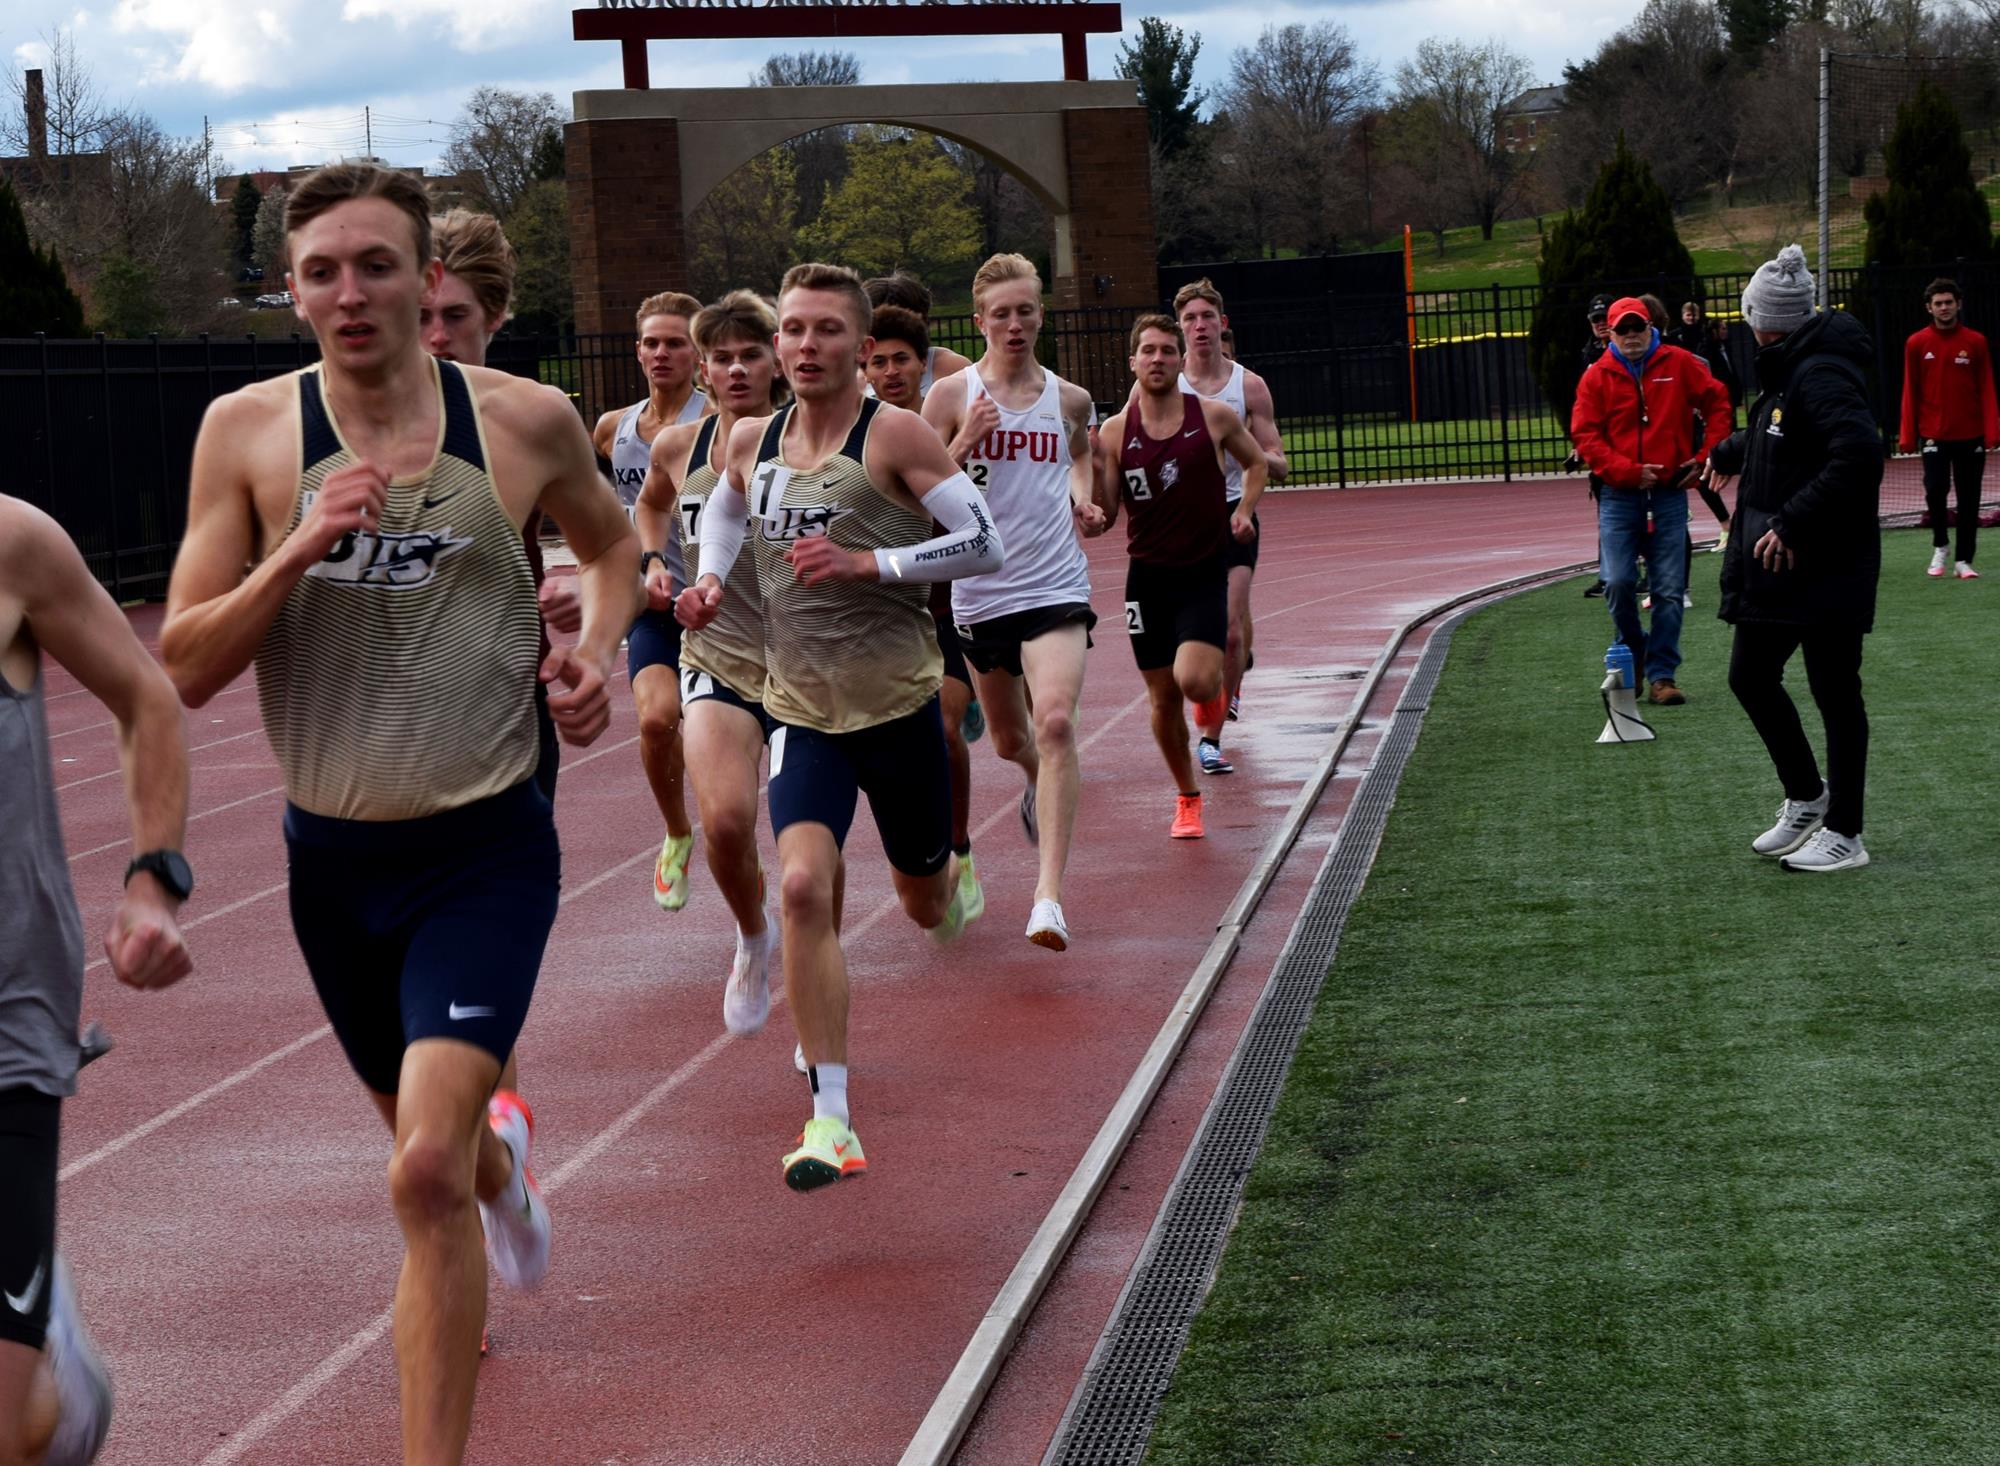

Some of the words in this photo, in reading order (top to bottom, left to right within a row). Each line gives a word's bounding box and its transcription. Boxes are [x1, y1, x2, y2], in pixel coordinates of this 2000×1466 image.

[758, 468, 777, 515] 1
[1129, 475, 1146, 496] 2
[682, 503, 701, 536] 7
[915, 540, 967, 562] PROTECT
[968, 532, 988, 550] THE
[1127, 607, 1139, 630] 2
[685, 669, 701, 694] 7
